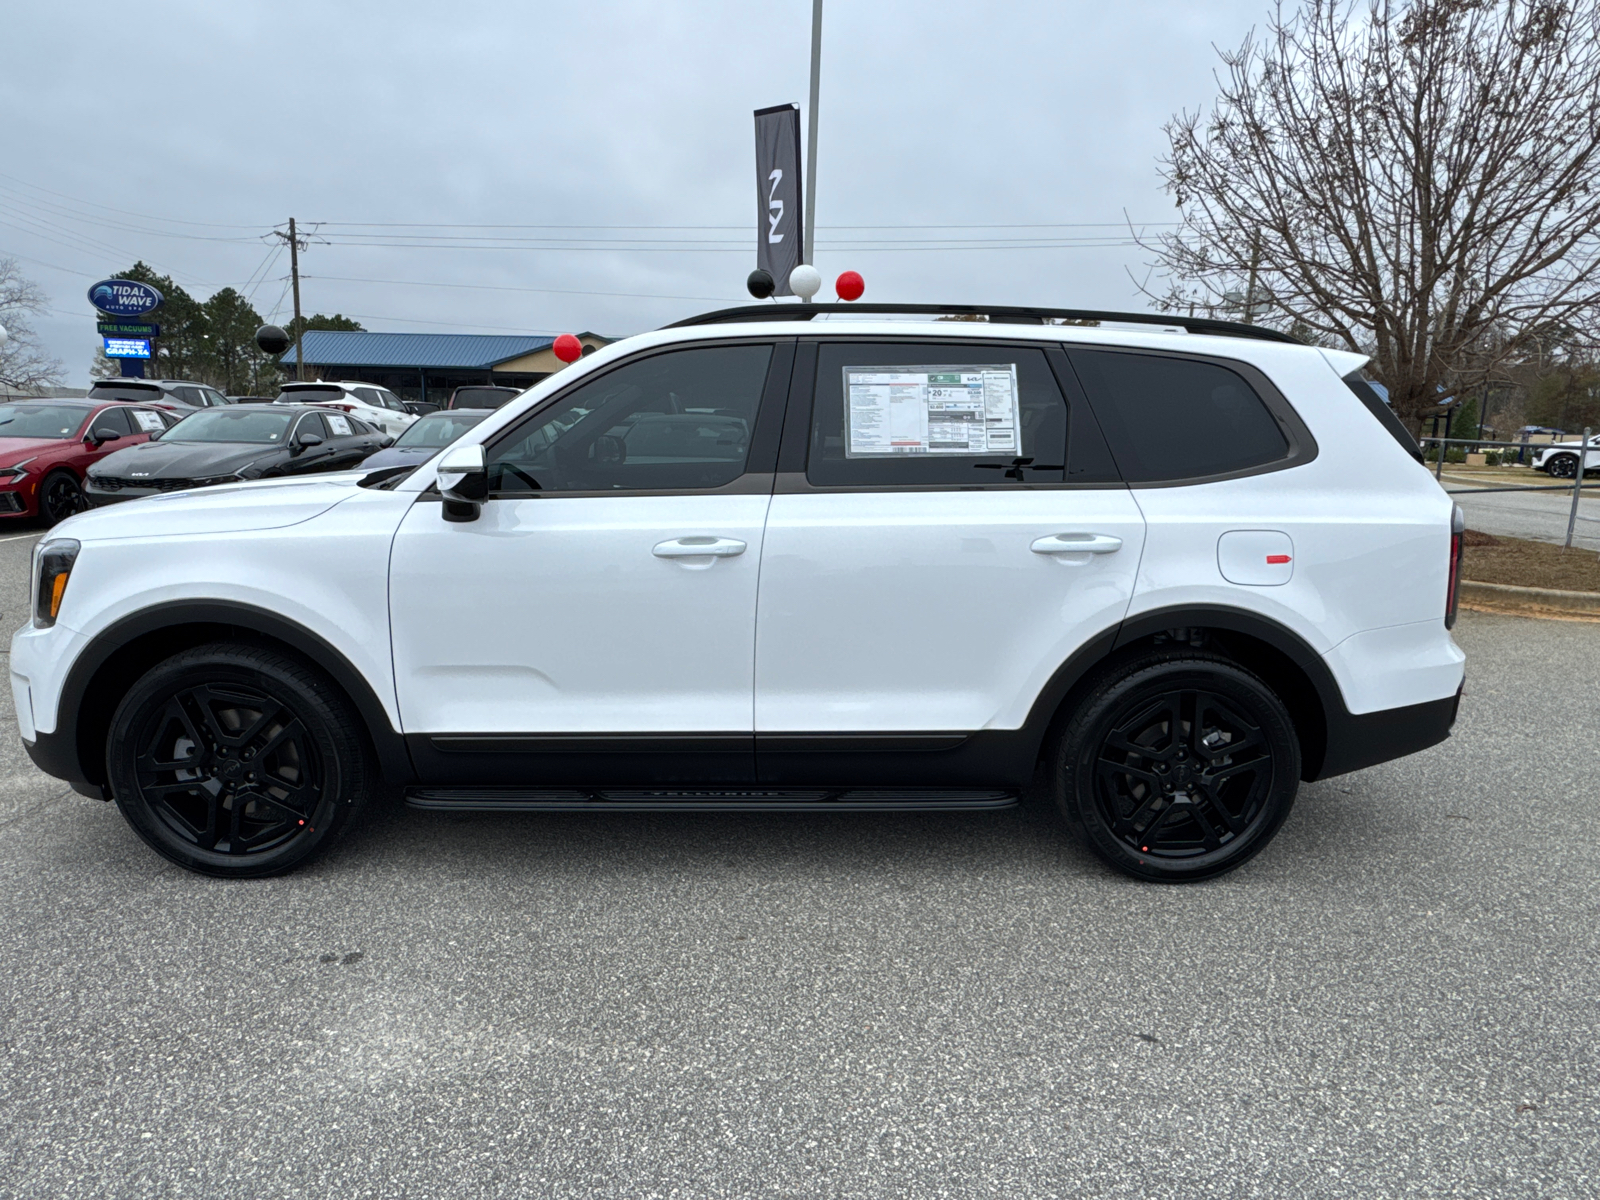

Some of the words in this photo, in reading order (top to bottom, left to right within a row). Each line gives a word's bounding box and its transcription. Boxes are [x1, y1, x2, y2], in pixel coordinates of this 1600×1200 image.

[113, 285, 145, 297] TIDAL
[118, 295, 153, 306] WAVE
[99, 324, 118, 332] FREE
[119, 324, 153, 333] VACUUMS
[105, 347, 150, 356] GRAPH-X4
[932, 389, 942, 397] 20
